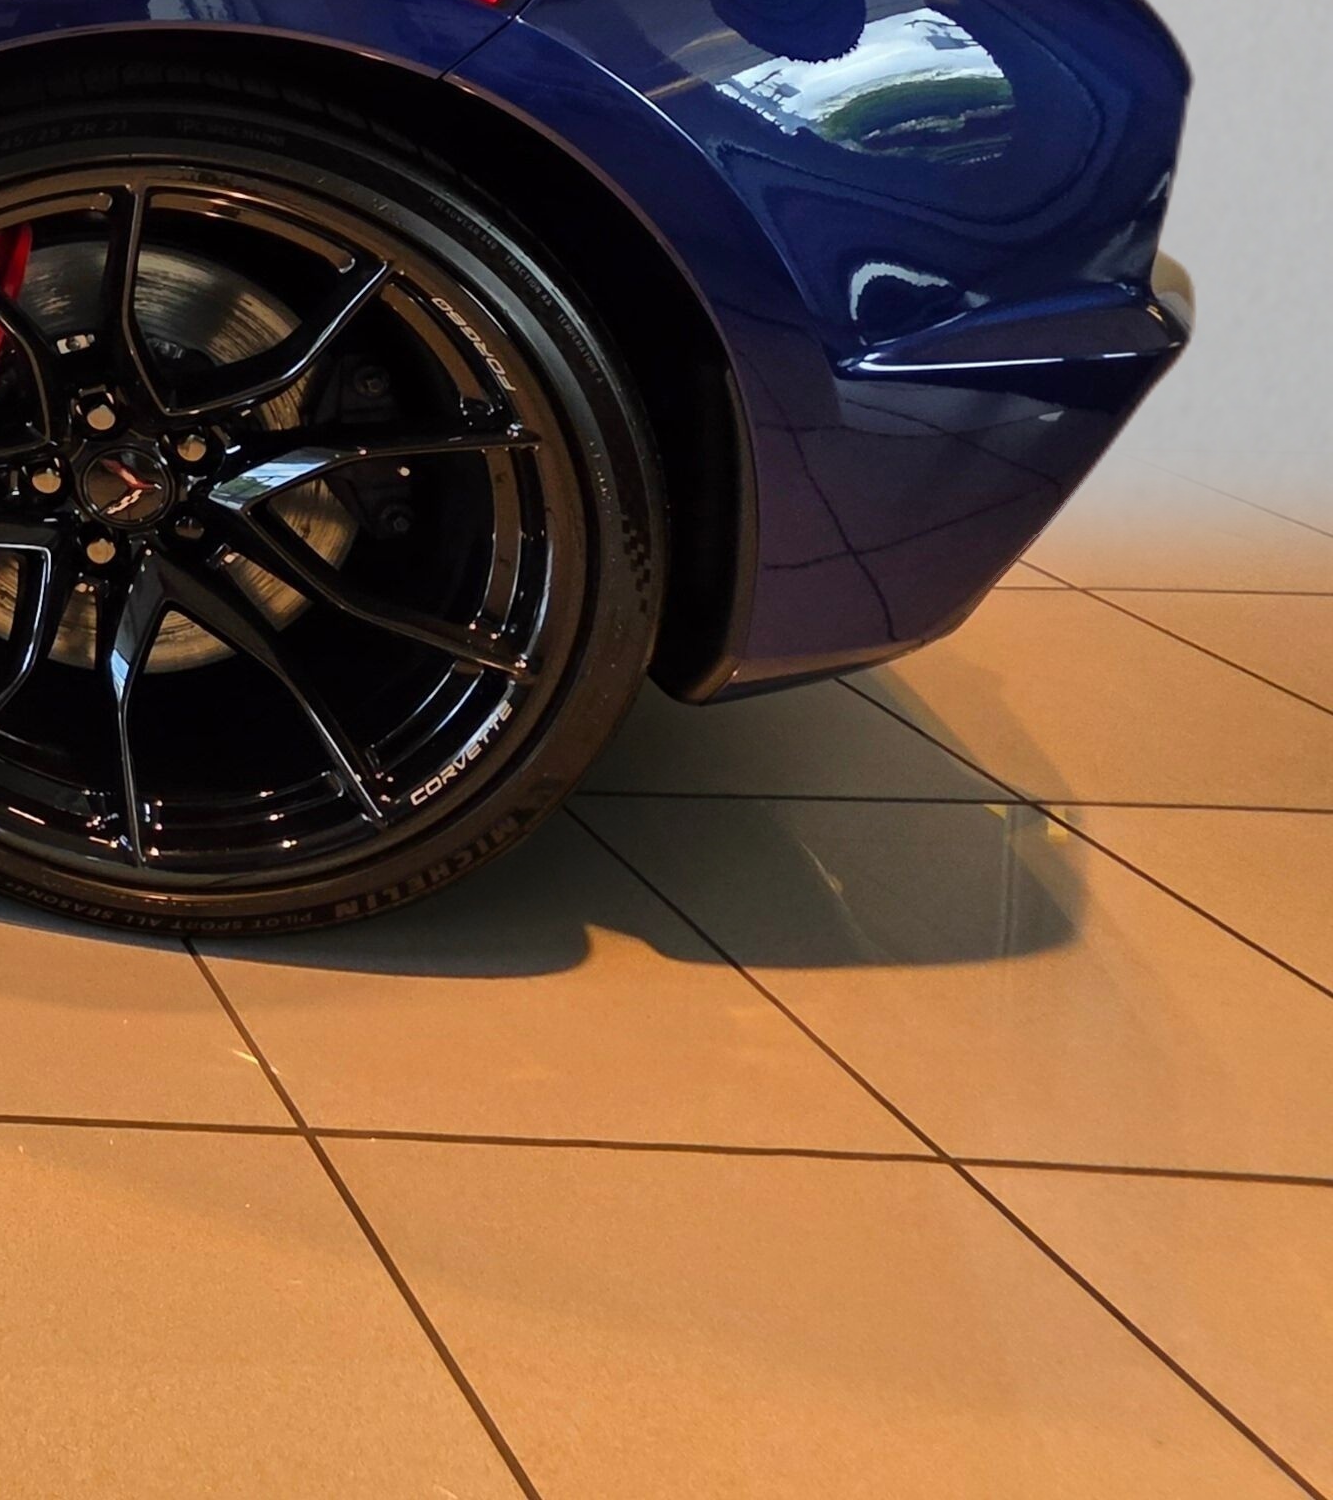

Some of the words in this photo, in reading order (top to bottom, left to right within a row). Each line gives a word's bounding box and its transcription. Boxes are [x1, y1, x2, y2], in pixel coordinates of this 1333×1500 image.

[431, 297, 517, 392] FORGED
[410, 699, 513, 805] CORVETTE
[335, 815, 520, 919] MICHELIN
[27, 888, 115, 920] SEASON
[251, 911, 312, 929] PILOT
[125, 913, 164, 928] ALL
[170, 917, 243, 931] SPORT
